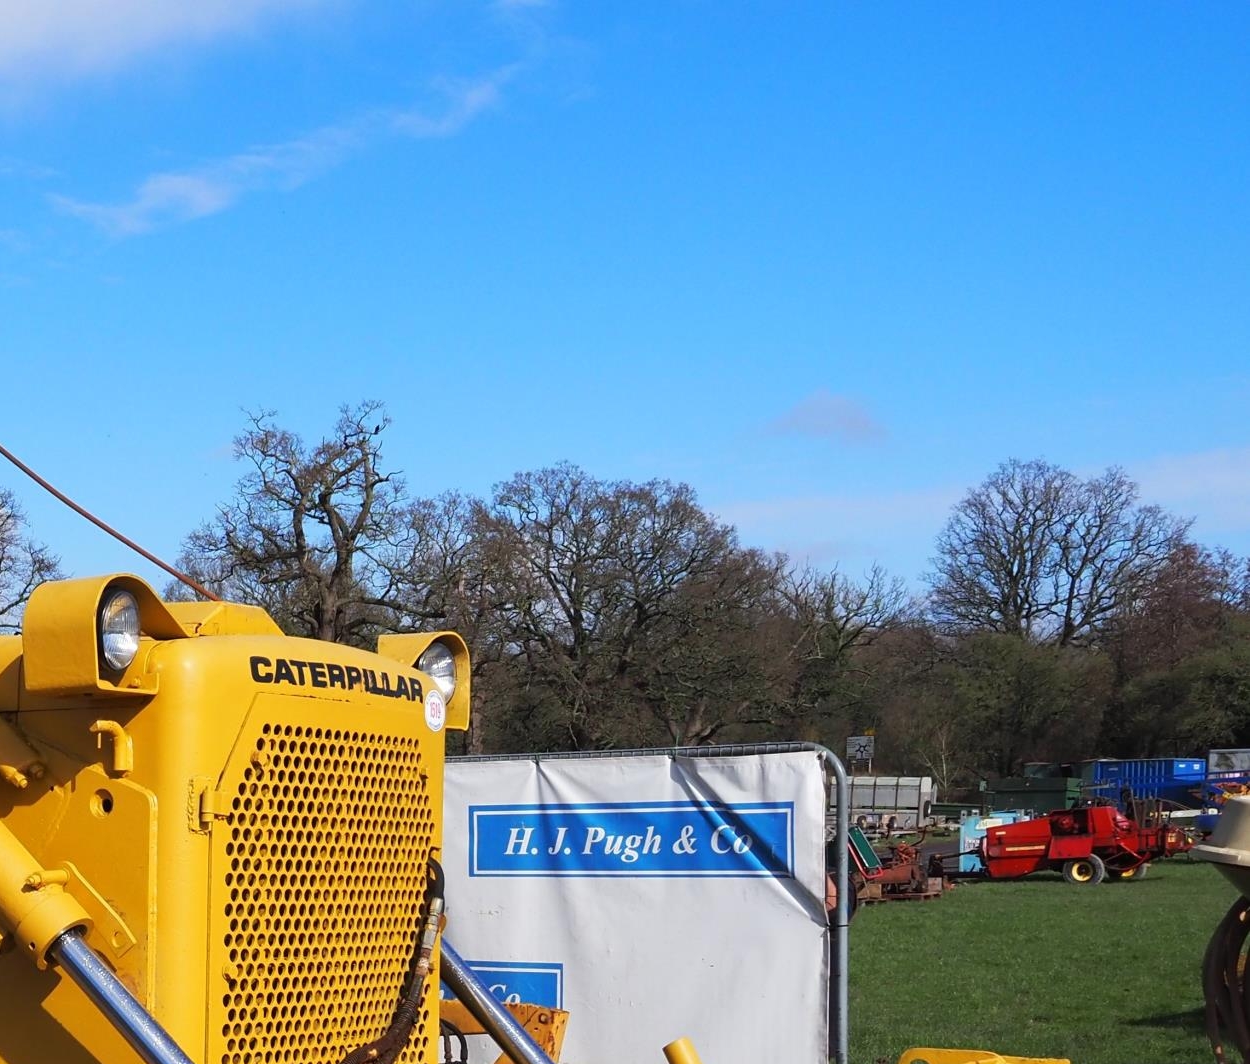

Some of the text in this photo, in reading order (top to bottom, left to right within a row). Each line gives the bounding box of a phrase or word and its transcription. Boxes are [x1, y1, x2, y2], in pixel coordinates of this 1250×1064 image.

[250, 656, 423, 704] CATERPILLAR
[503, 824, 753, 863] H. J. Pugh & Co
